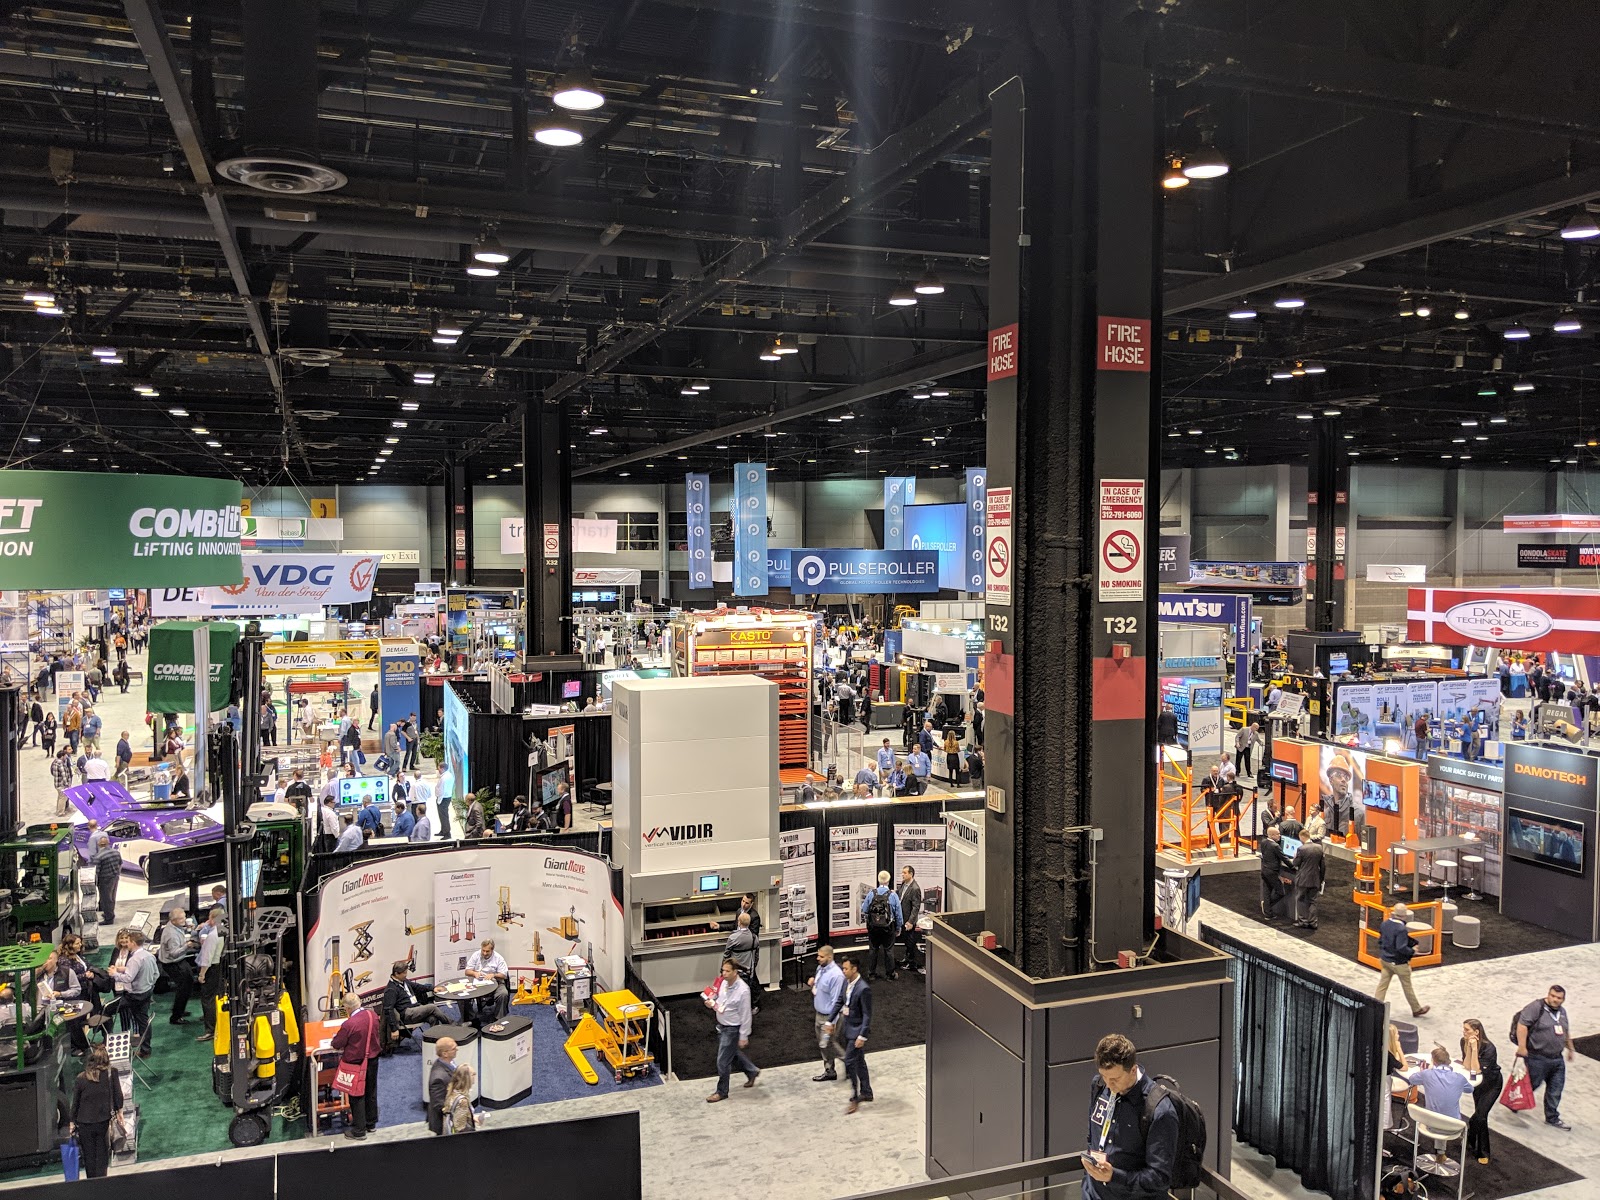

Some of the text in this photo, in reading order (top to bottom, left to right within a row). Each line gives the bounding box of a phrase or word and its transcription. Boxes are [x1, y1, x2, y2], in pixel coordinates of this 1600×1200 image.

[1108, 324, 1141, 342] FIRE
[992, 331, 1013, 353] FIRE
[1105, 345, 1144, 364] HOSE
[991, 352, 1014, 373] HOSE
[399, 551, 416, 560] Exit
[252, 565, 335, 586] VDG
[829, 562, 935, 575] PULSEROLLER
[1101, 580, 1142, 588] NO SMOKING
[255, 586, 331, 600] Van der Graaf
[1473, 608, 1522, 619] DANE
[989, 614, 1008, 632] T32
[1103, 616, 1137, 634] T32
[1456, 616, 1539, 628] TECHNOLOGIES
[730, 631, 771, 641] KASTO
[275, 655, 316, 664] DEMAG
[385, 661, 415, 673] 200
[1546, 709, 1568, 718] REGAL
[1439, 765, 1452, 774] YOUR
[1453, 768, 1466, 776] RACK
[1467, 771, 1487, 780] SAFETY
[1514, 763, 1587, 786] DAMOTECH
[669, 823, 713, 841] VIDIR
[783, 834, 799, 842] VIDIR
[841, 827, 859, 835] VIDIR
[958, 823, 978, 844] VIDIR
[544, 857, 586, 874] GiantMove
[341, 872, 384, 894] GiantMove
